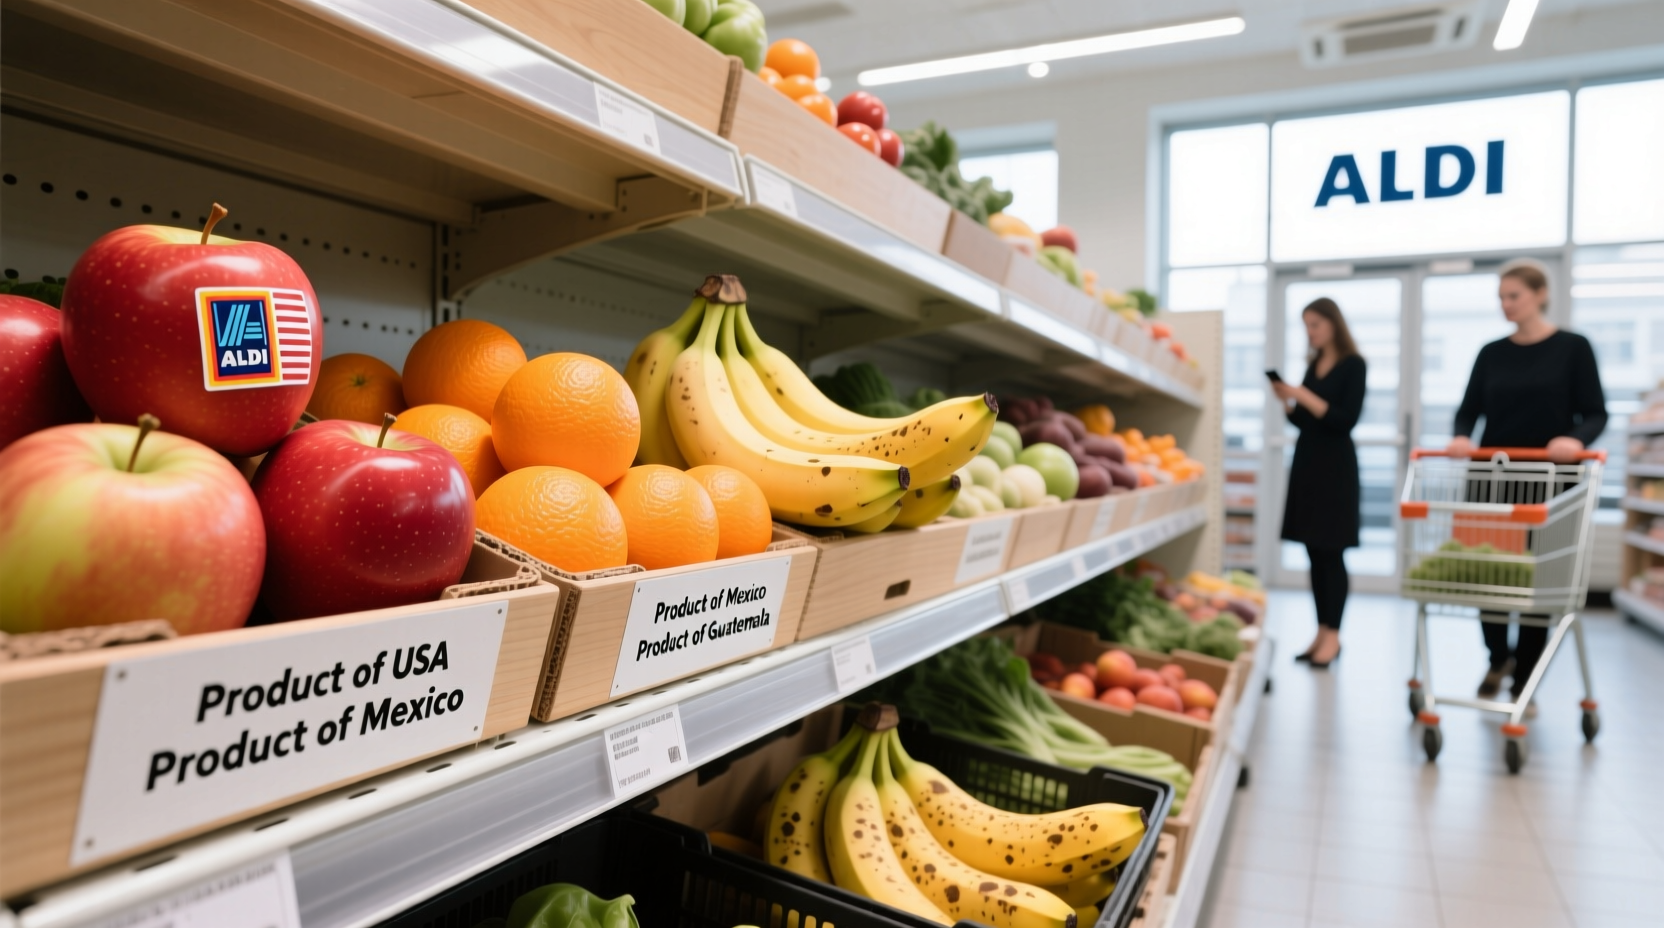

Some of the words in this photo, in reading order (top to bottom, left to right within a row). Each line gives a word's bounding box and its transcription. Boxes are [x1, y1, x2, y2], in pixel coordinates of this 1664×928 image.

[1314, 139, 1506, 208] ALDI
[221, 348, 268, 368] ALDI
[654, 593, 708, 624] Product
[710, 588, 725, 611] of
[725, 583, 767, 608] Mexico
[636, 629, 689, 662] Product
[691, 623, 707, 646] of
[196, 661, 346, 723] Product
[352, 650, 389, 689] of
[392, 640, 449, 680] USA
[145, 720, 308, 792] Product
[316, 705, 356, 746] of
[359, 685, 465, 736] Mexico
